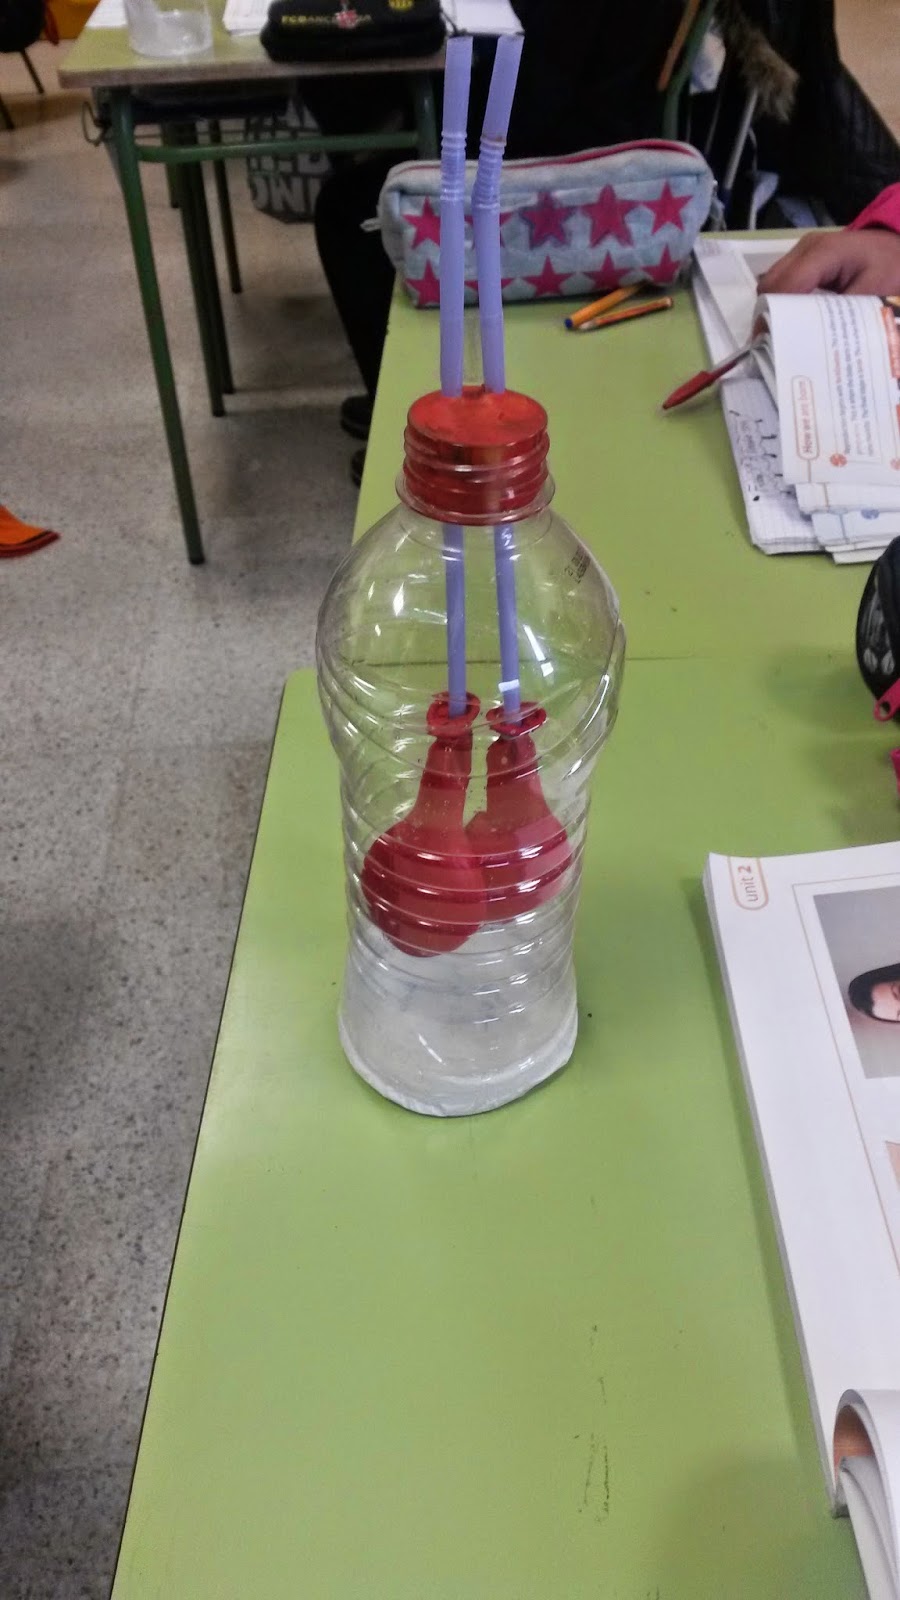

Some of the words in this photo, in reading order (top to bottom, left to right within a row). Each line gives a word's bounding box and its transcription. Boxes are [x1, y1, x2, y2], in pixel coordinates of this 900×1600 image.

[802, 432, 813, 454] How
[737, 865, 752, 874] 2
[741, 876, 759, 902] unit
